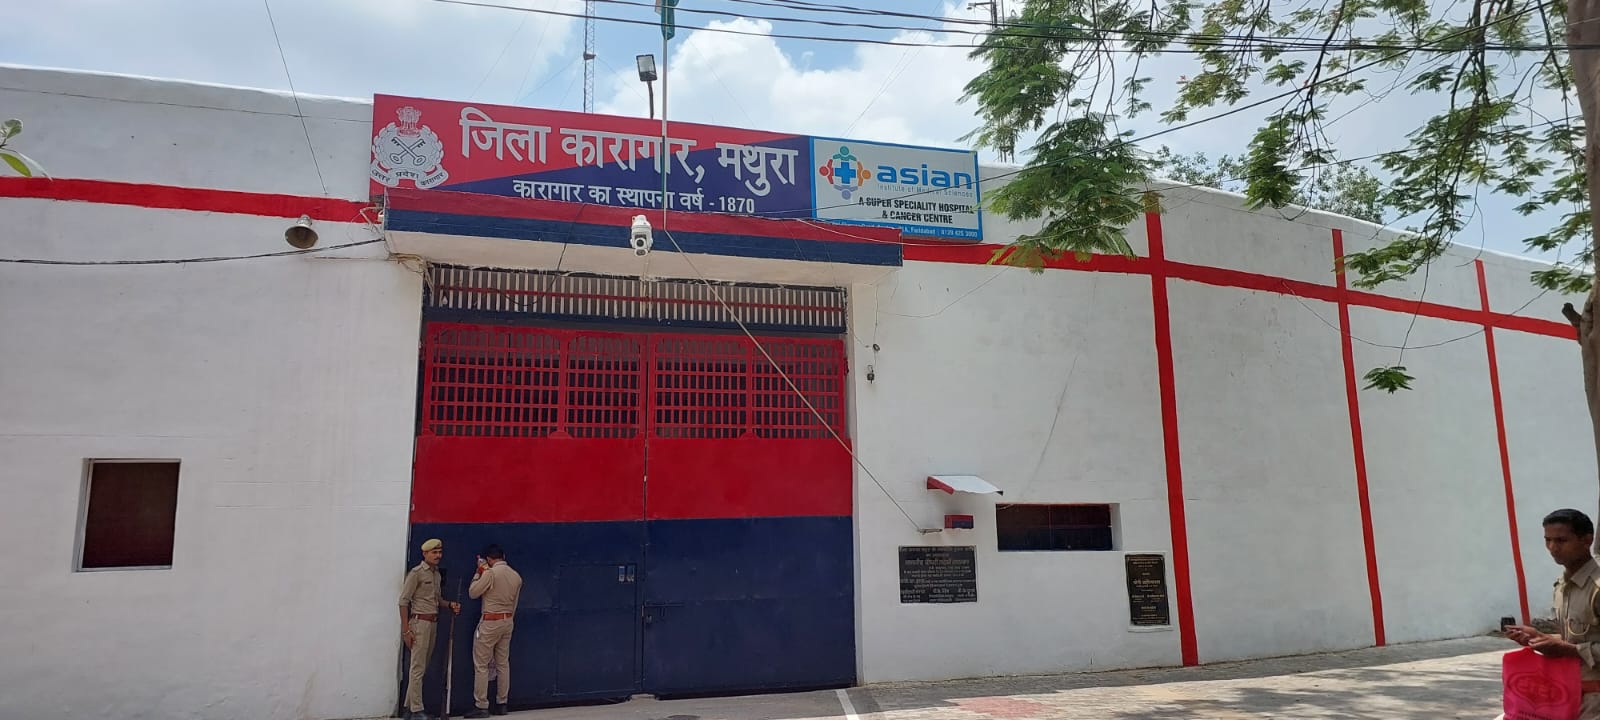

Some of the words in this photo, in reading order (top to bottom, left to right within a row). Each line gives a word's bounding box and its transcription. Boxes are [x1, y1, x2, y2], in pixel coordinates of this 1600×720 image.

[458, 106, 551, 164] जिला
[559, 127, 705, 184] कारागार,
[715, 142, 799, 197] मथुरा
[876, 163, 972, 190] asian
[512, 178, 585, 203] कारागार
[588, 185, 610, 204] का
[615, 186, 674, 210] स्थापना
[678, 187, 705, 211] वर्ष
[718, 196, 755, 214] 1870
[858, 196, 865, 206] A
[866, 196, 892, 208] SUPER
[893, 199, 937, 211] SPECIALITY
[881, 210, 888, 219] &
[889, 211, 923, 222] CANCER
[923, 213, 953, 224] CENTRE
